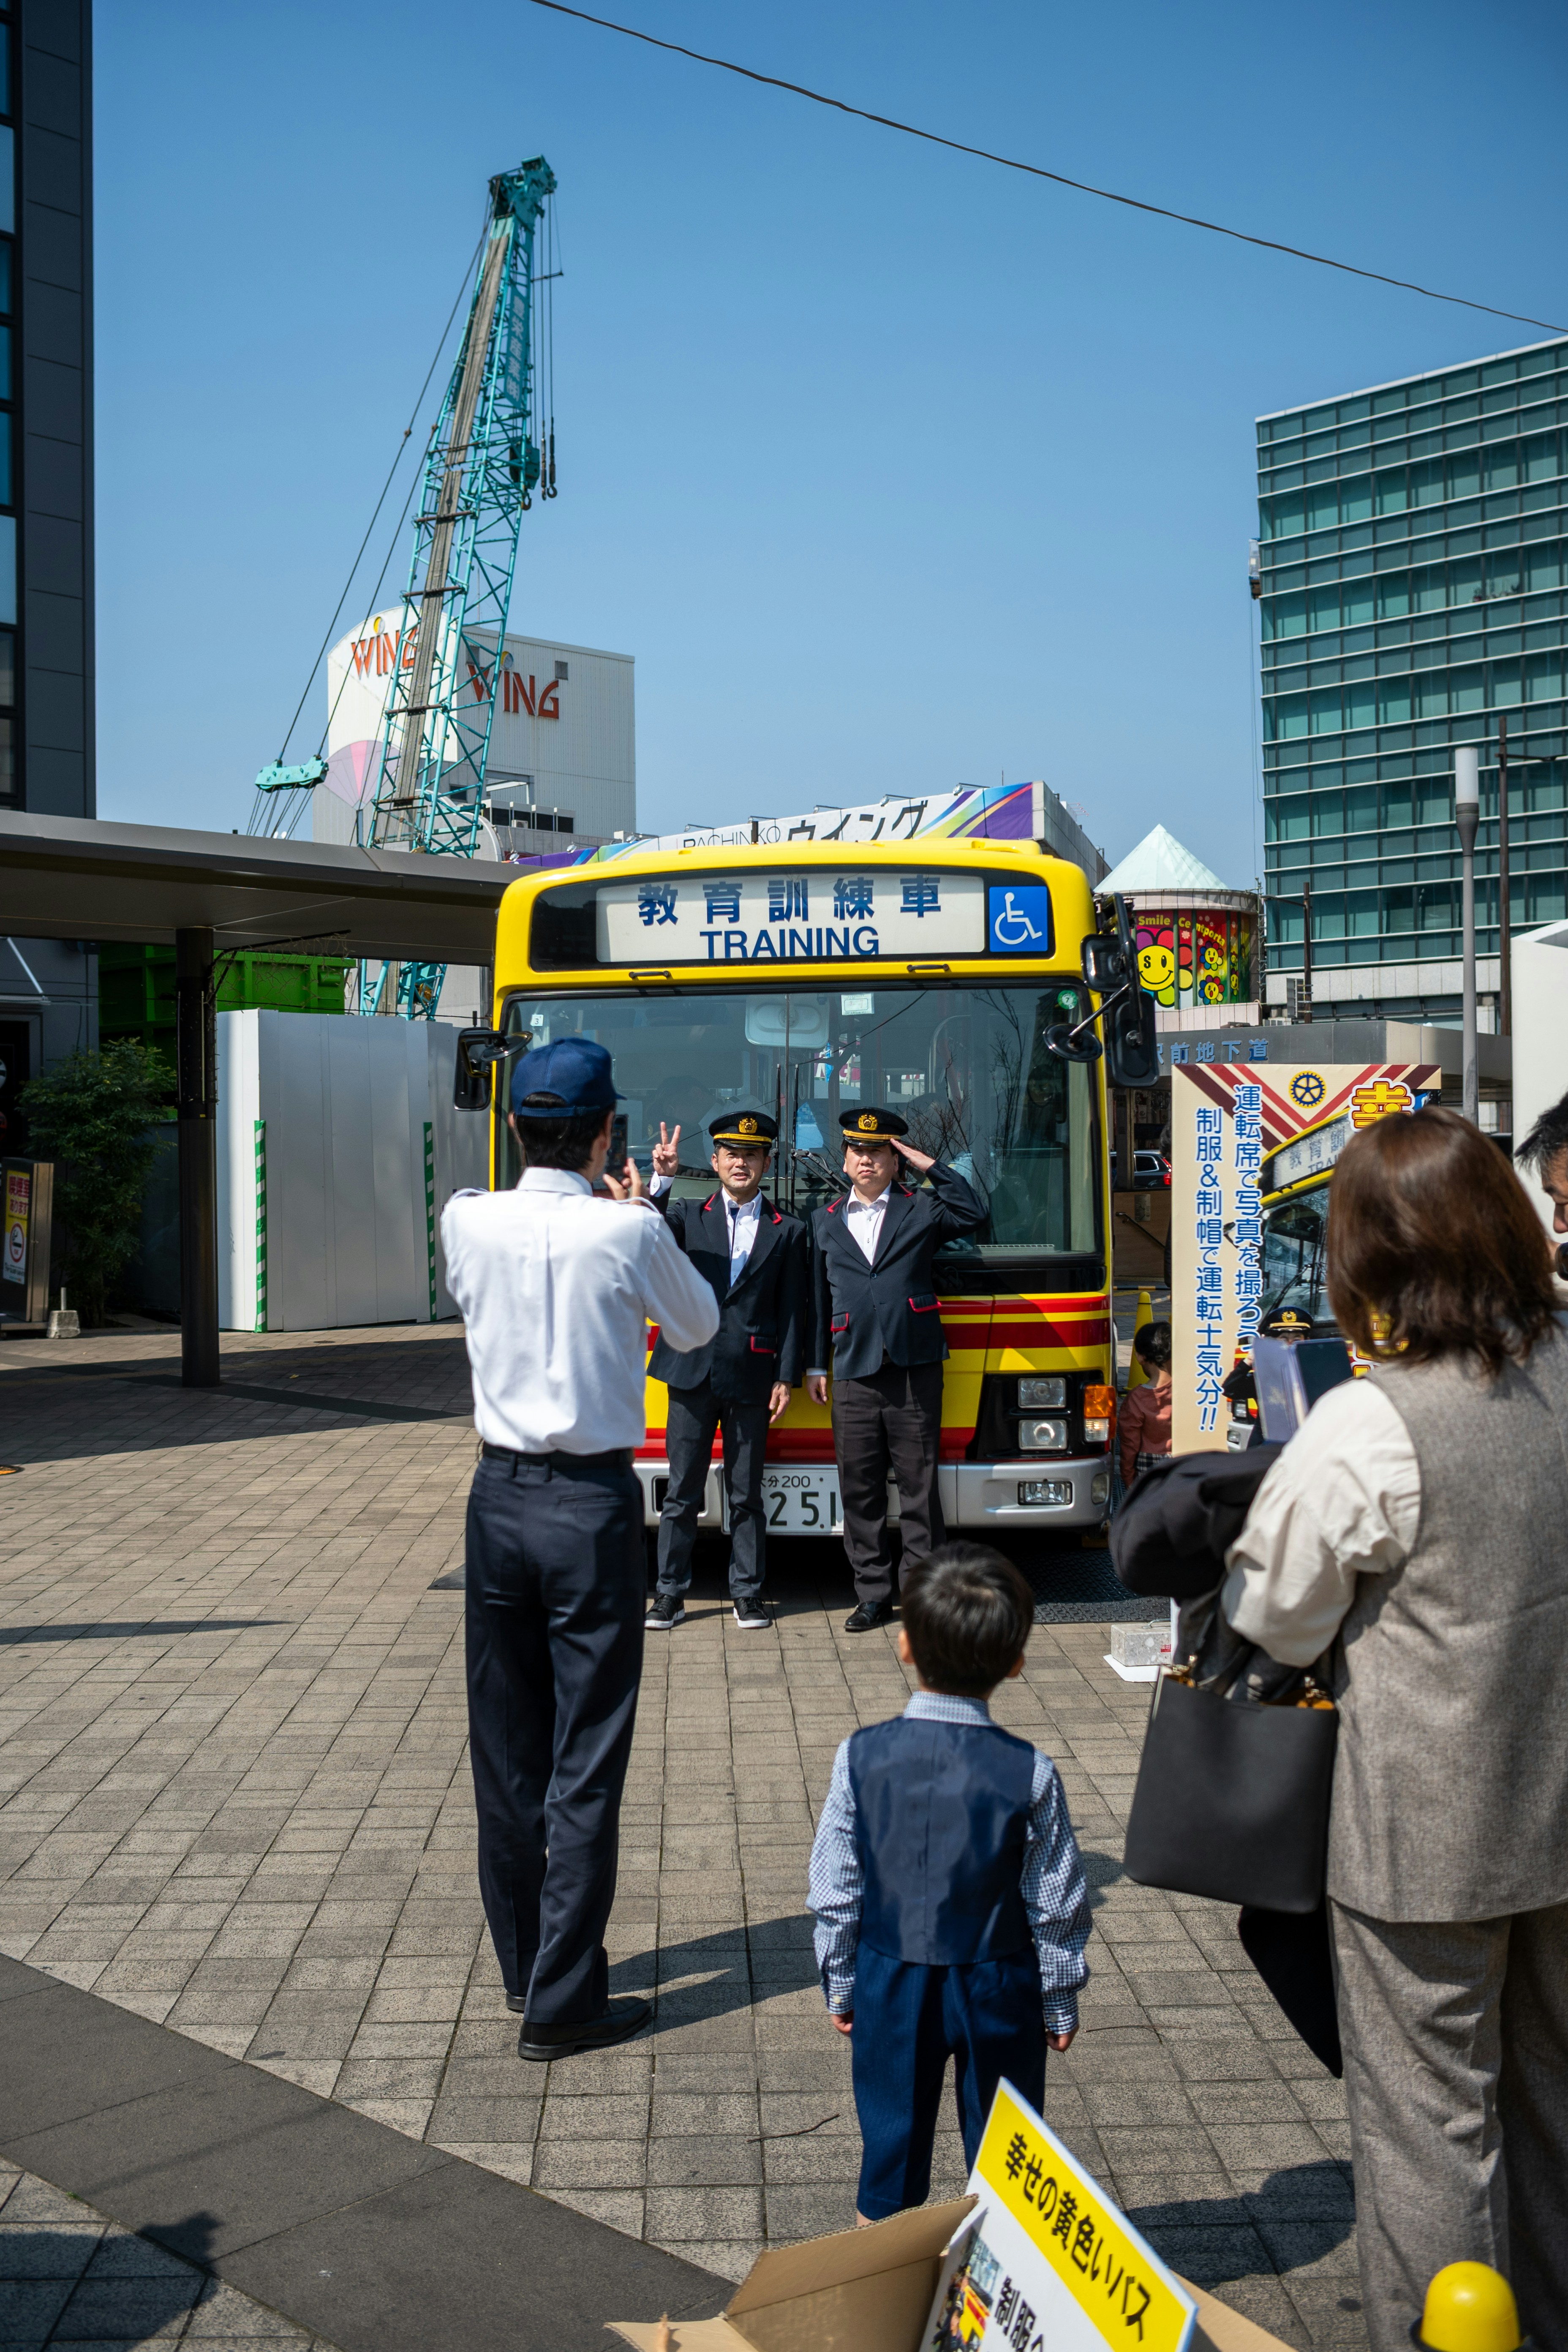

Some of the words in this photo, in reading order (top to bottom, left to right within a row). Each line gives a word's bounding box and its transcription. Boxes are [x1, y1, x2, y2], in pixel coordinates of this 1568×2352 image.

[637, 874, 942, 926] 教育訓練車
[1138, 915, 1171, 926] Smile
[700, 926, 879, 959] TRAINING
[1004, 2132, 1151, 2342] 幸せの黄色いバス
